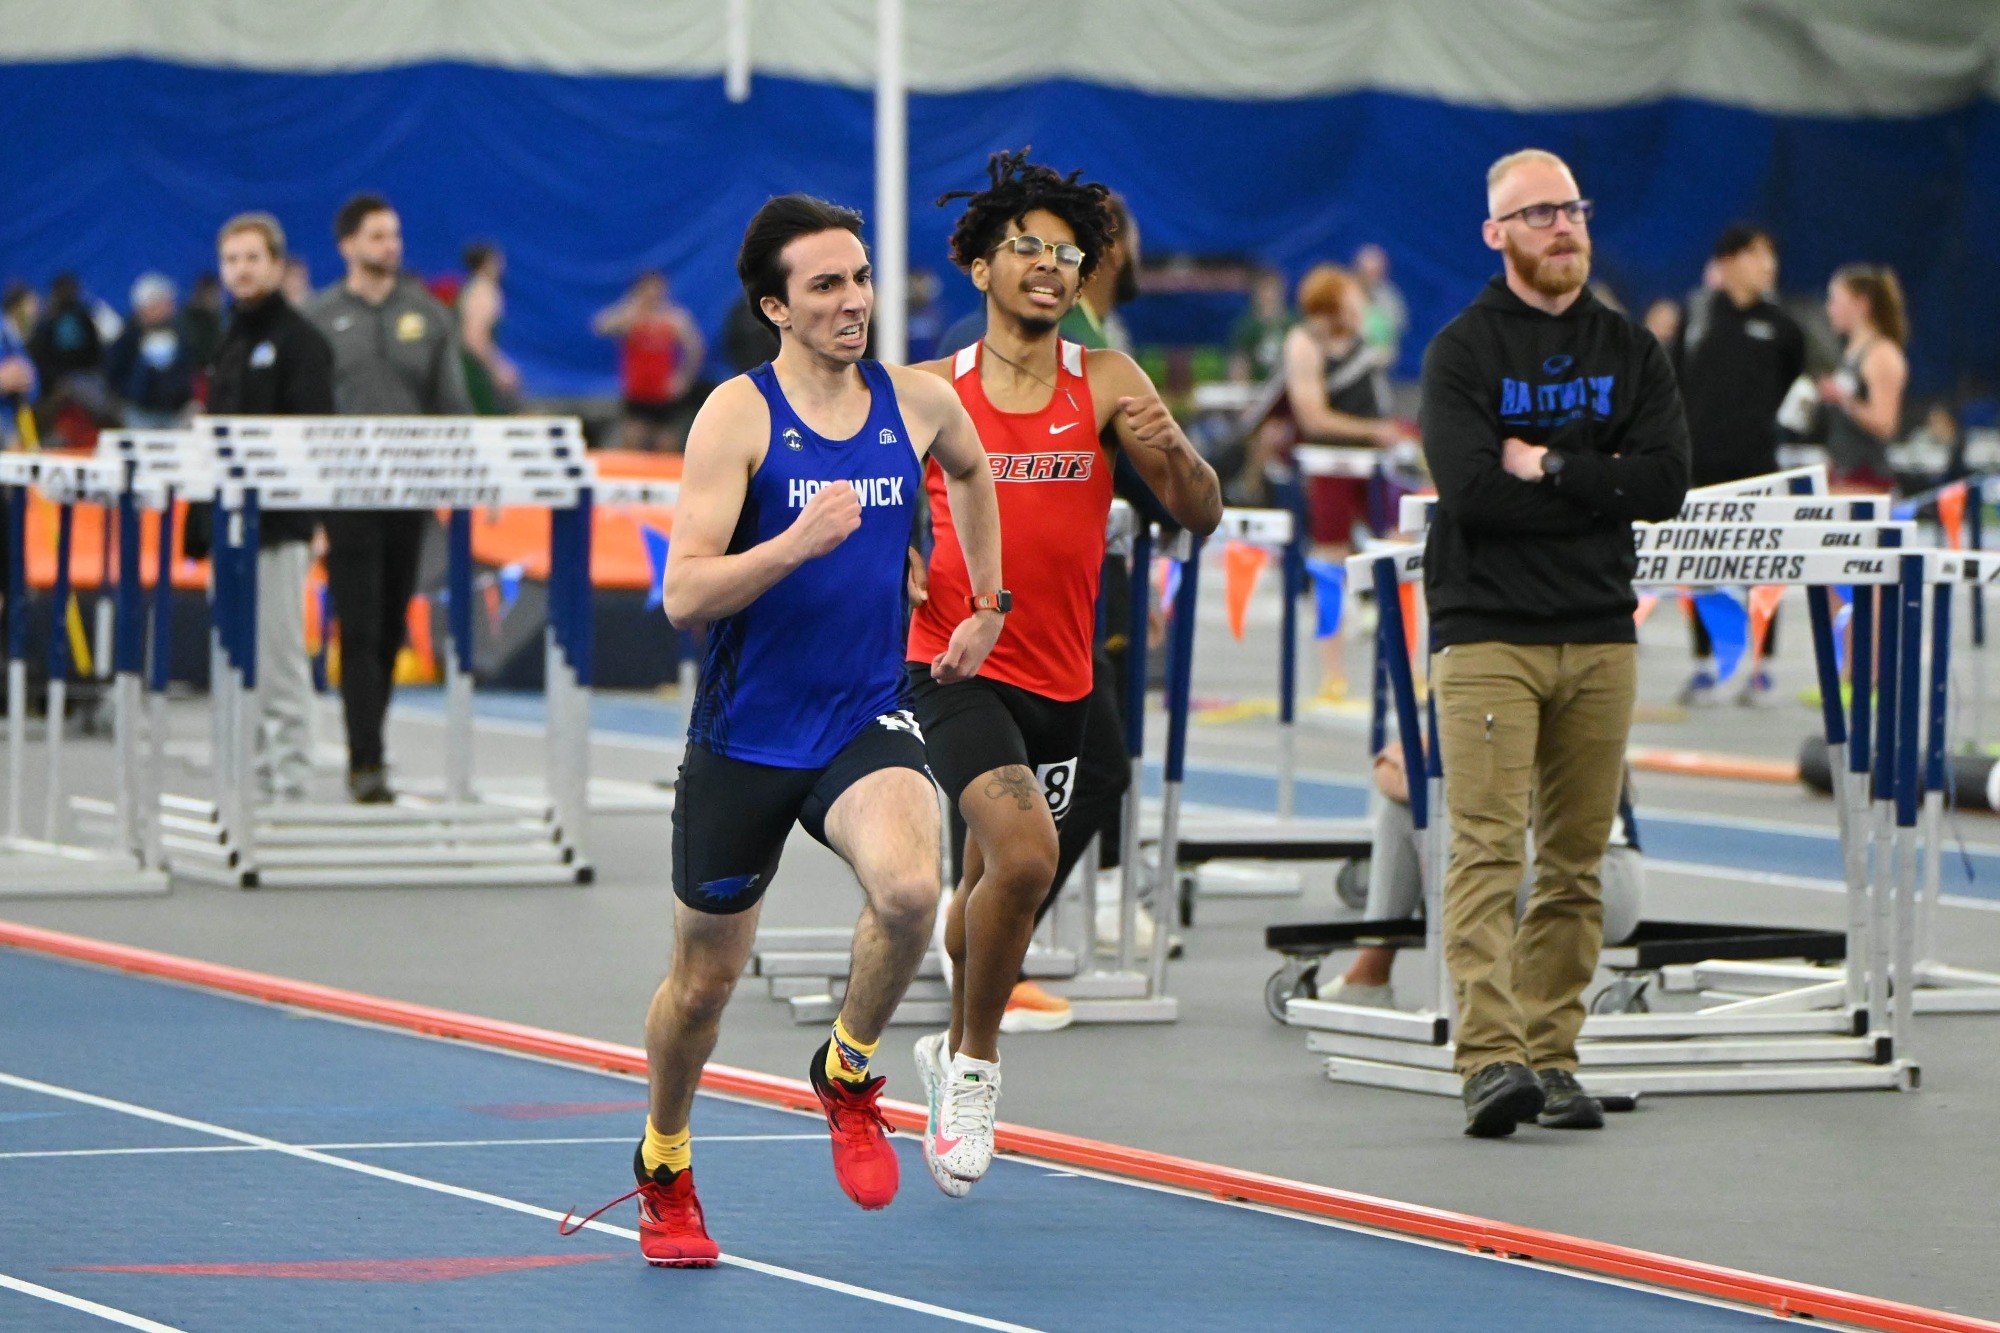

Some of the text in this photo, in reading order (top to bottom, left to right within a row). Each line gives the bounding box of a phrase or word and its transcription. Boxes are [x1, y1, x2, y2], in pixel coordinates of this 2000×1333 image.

[986, 454, 1092, 480] BERTS
[788, 477, 904, 508] HAWICK
[1794, 507, 1834, 521] GILL
[1655, 528, 1783, 550] PIONEERS
[1821, 533, 1861, 547] GILL
[1676, 555, 1805, 580] PIONEERS
[1044, 765, 1070, 810] 8
